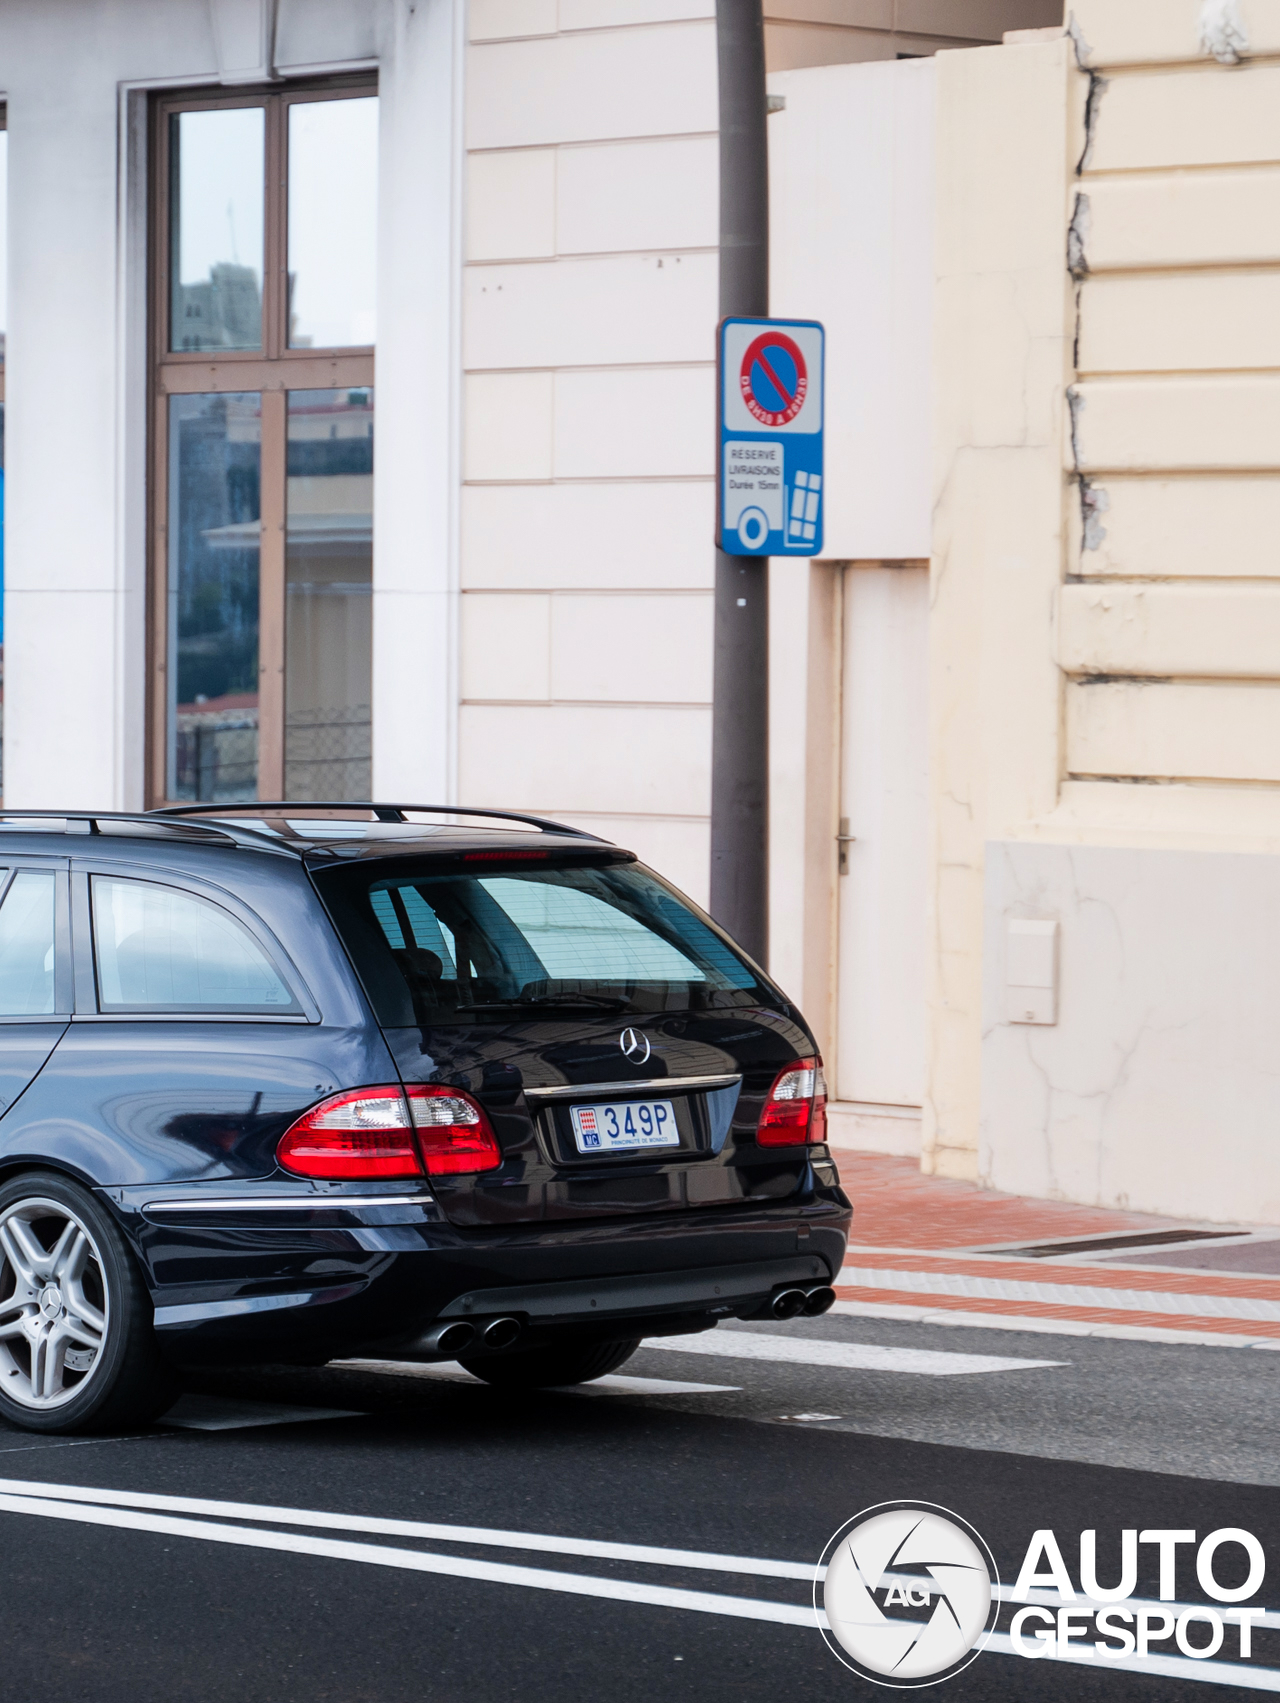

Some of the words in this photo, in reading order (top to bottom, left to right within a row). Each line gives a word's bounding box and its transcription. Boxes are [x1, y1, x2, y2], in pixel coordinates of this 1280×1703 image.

[740, 376, 751, 396] DE
[728, 464, 781, 476] LIVRAISONS
[728, 479, 754, 490] Durée
[604, 1104, 668, 1139] 349P
[585, 1134, 598, 1146] MC
